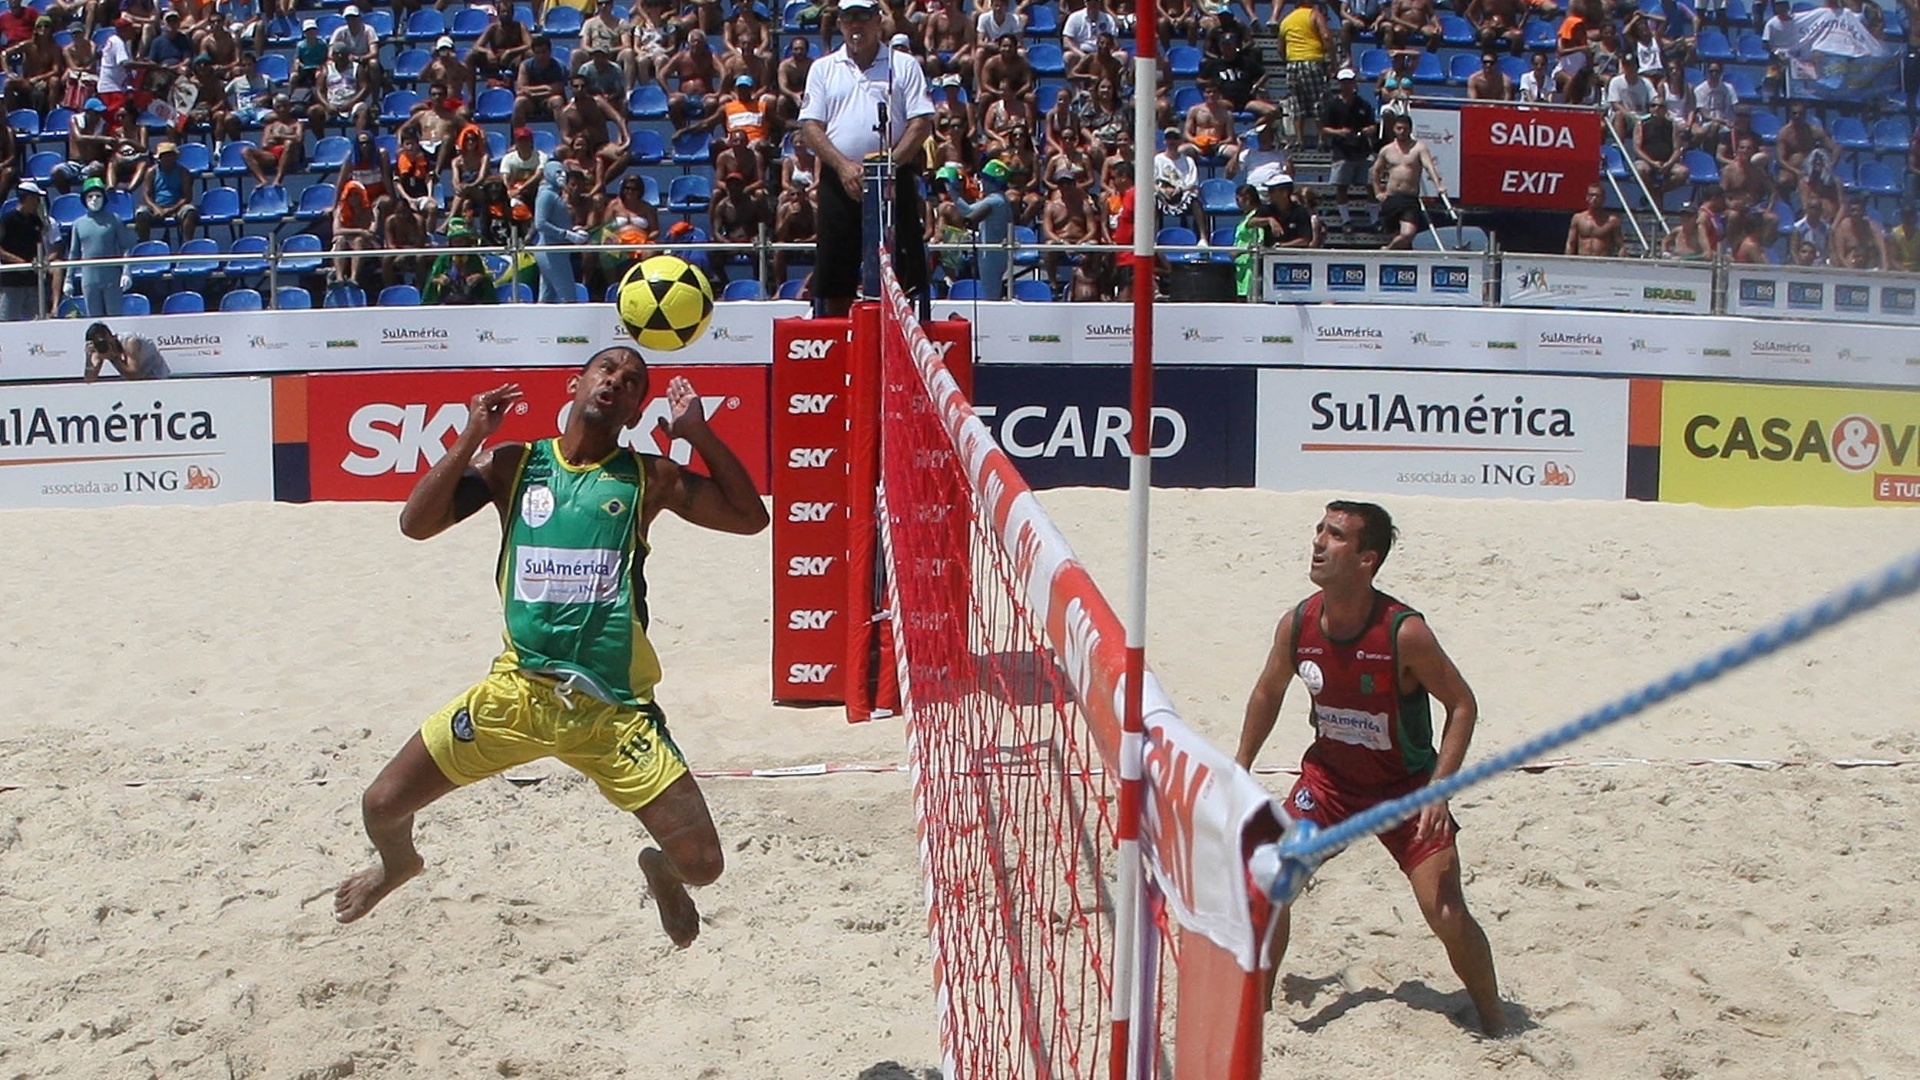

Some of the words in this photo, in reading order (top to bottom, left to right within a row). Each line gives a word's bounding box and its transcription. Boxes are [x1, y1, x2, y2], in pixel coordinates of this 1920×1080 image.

[1490, 118, 1575, 149] SAÍDA
[1501, 170, 1563, 194] EXIT
[1644, 287, 1696, 302] BRASIL
[382, 327, 448, 339] SulAmérica
[1086, 323, 1135, 335] SulAmé
[1317, 325, 1383, 338] SulAmérica
[1541, 332, 1602, 345] SulAmérica
[157, 334, 221, 346] SulAmérica
[787, 339, 834, 359] SKY
[788, 394, 834, 414] SKY
[1310, 391, 1575, 437] SulAmérica
[788, 448, 834, 468] SKY
[41, 480, 100, 495] associada
[103, 482, 119, 493] ao
[123, 470, 178, 492] ING
[1396, 470, 1457, 484] associada
[1460, 473, 1476, 484] ao
[1481, 464, 1535, 486] ING
[1879, 477, 1890, 497] É
[788, 502, 833, 522] SKY
[525, 559, 609, 576] SulAmérica
[787, 556, 833, 576] SKY
[788, 610, 833, 630] SKY
[787, 664, 832, 683] SKY
